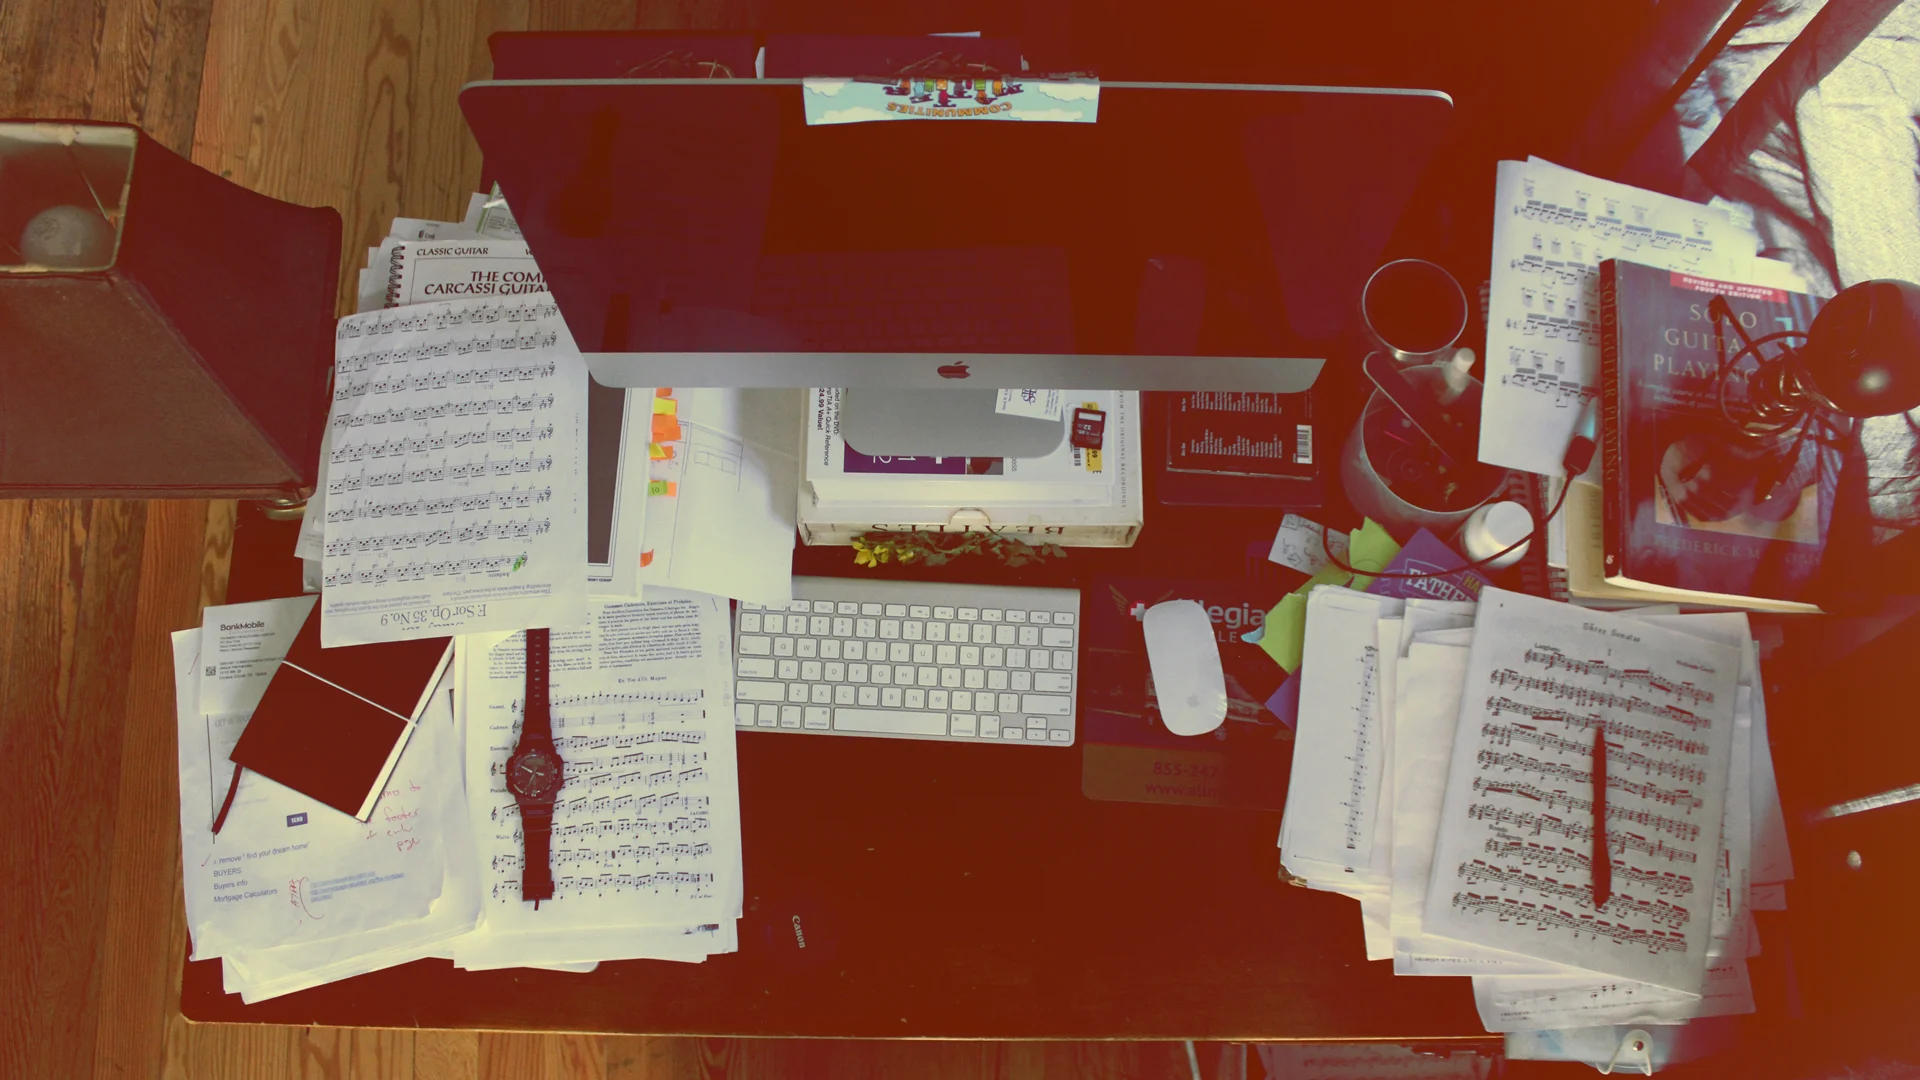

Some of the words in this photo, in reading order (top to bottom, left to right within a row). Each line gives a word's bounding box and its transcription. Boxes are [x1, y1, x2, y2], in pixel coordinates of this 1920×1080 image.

[886, 101, 1014, 119] COMMUNITIES
[417, 248, 453, 256] CLASSIC
[454, 247, 489, 255] GUITAR
[471, 271, 500, 283] THE
[424, 283, 496, 296] CARCASSI
[1664, 328, 1753, 356] GUITA
[817, 409, 825, 430] Value!
[823, 435, 831, 466] Reference
[389, 612, 411, 625] No.
[412, 609, 428, 623] 35
[430, 605, 452, 621] Op.
[452, 604, 475, 619] Sor
[220, 621, 265, 631] BankMobile
[380, 614, 389, 627] 9
[1152, 761, 1218, 778] 855-247
[218, 855, 241, 864] remove
[258, 850, 271, 859] your
[272, 847, 290, 855] dream
[213, 867, 242, 877] BUYERS
[213, 881, 235, 891] Buyers
[236, 879, 248, 887] info
[213, 894, 243, 903] Mortgage
[244, 888, 278, 899] Calculators
[792, 915, 806, 949] Canon
